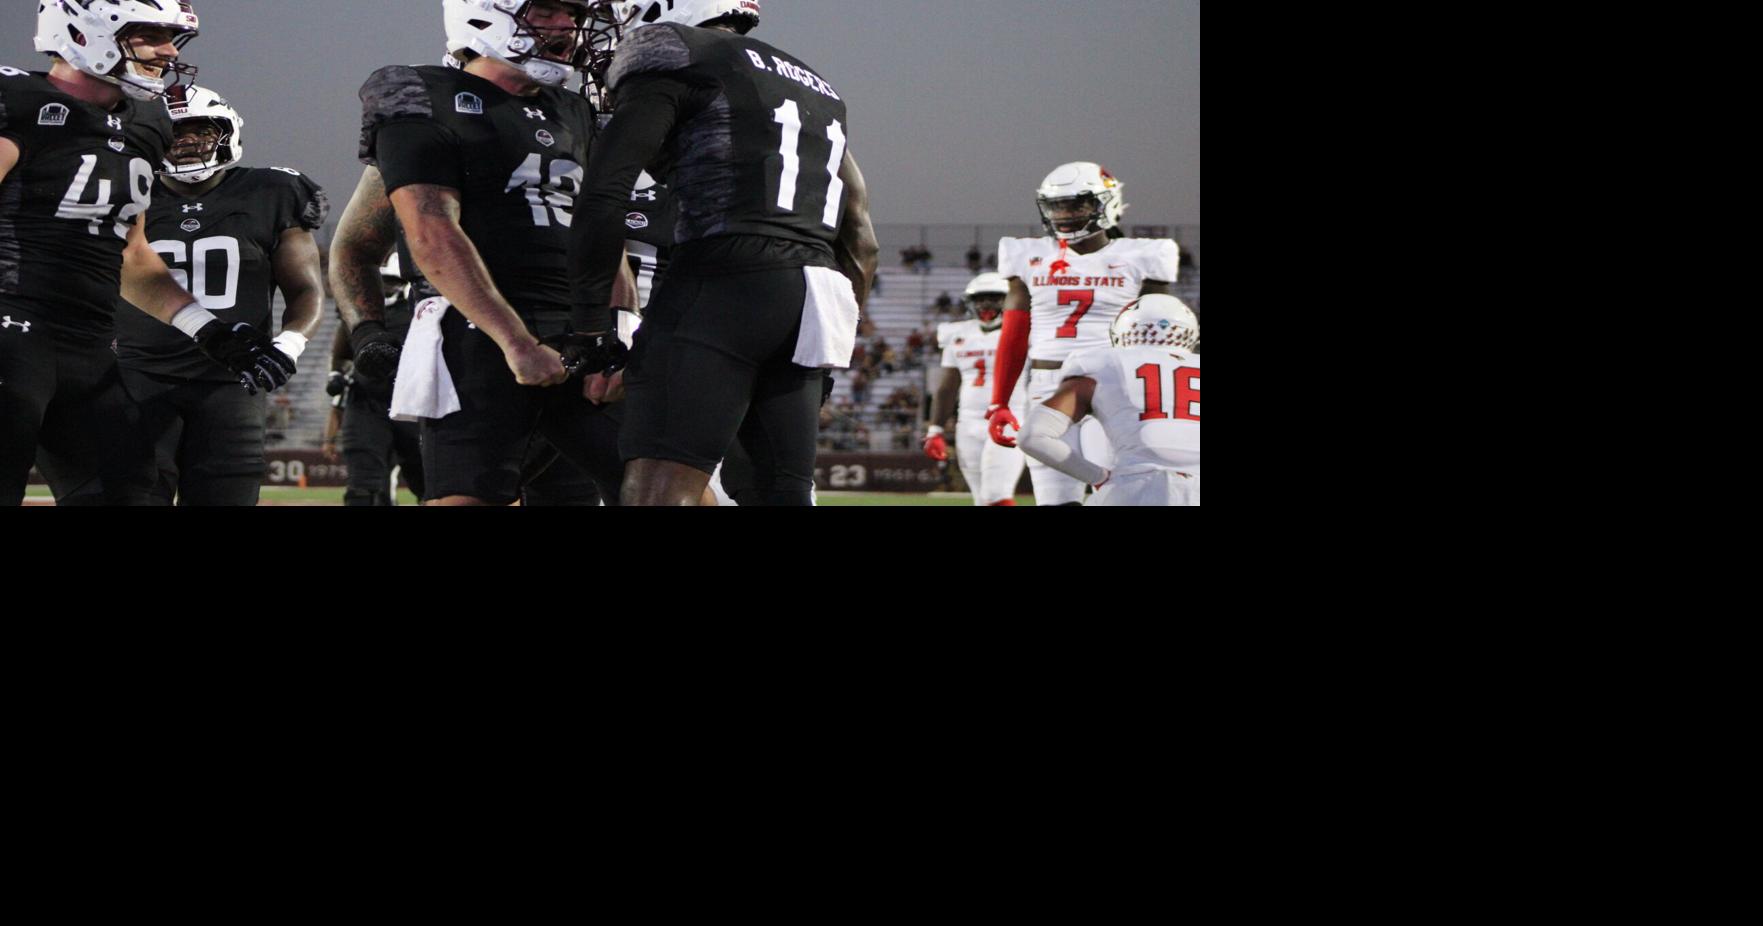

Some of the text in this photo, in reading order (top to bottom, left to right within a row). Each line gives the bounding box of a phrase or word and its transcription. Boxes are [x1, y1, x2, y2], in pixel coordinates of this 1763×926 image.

[745, 49, 840, 100] B. ROGERS
[171, 107, 188, 115] SIU
[774, 99, 846, 228] 11
[54, 154, 154, 240] 48
[148, 236, 240, 310] 60
[1033, 276, 1126, 287] ILLINOIS STATE
[1056, 289, 1095, 339] 7
[973, 358, 986, 387] 1
[269, 460, 304, 482] 30
[829, 464, 866, 487] 23
